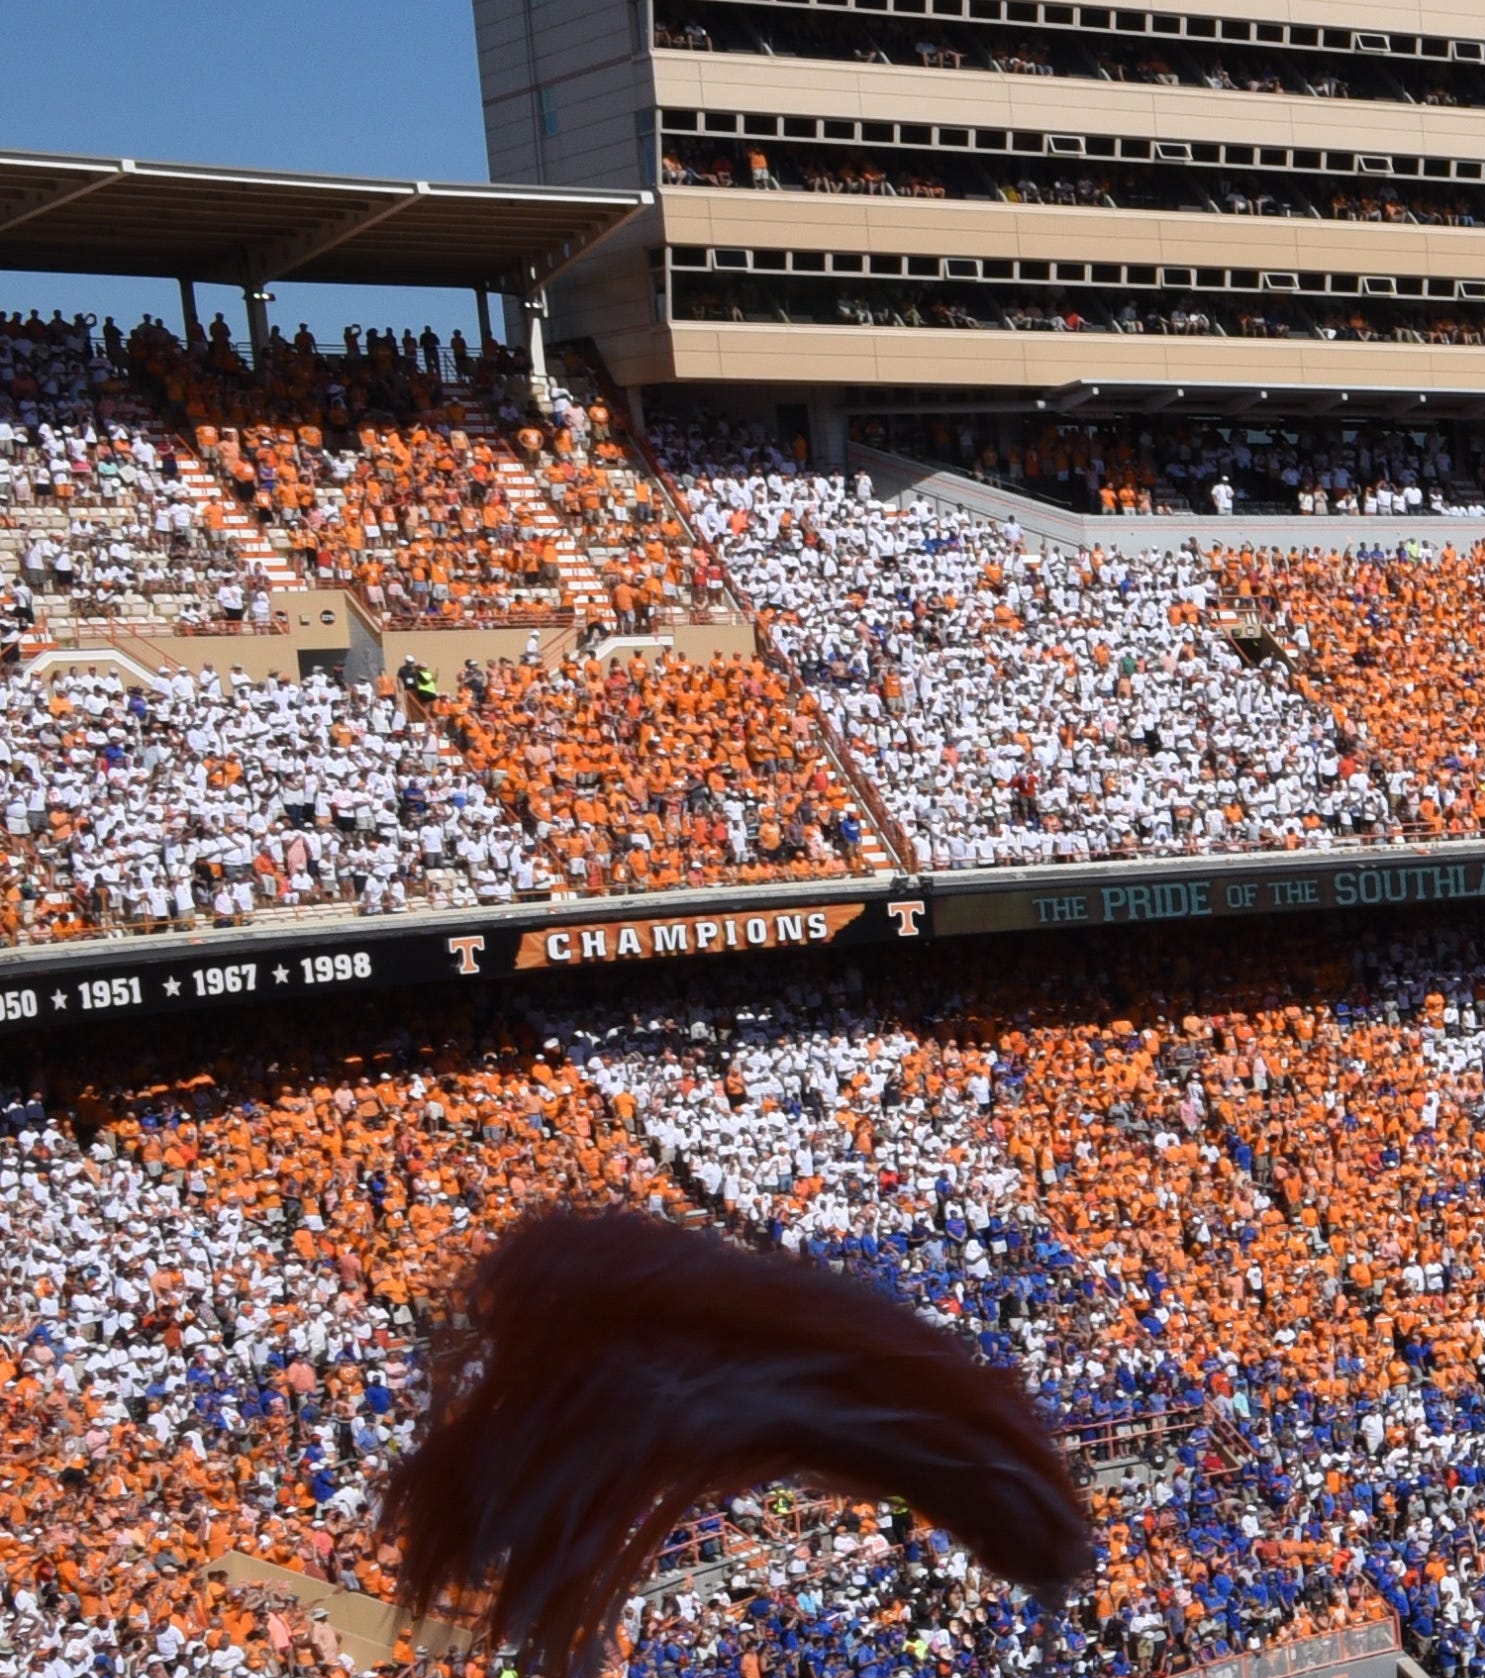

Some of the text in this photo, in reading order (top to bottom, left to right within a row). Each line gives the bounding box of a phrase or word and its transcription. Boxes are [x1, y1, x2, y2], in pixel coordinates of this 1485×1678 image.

[1033, 897, 1088, 922] THE
[1101, 881, 1212, 921] PRIDE
[1226, 883, 1256, 908] OF
[1268, 880, 1319, 907] THE
[547, 912, 827, 961] CHAMPIONS
[78, 976, 143, 1010] 1951
[192, 963, 257, 996] 1967
[300, 951, 372, 984] 1998
